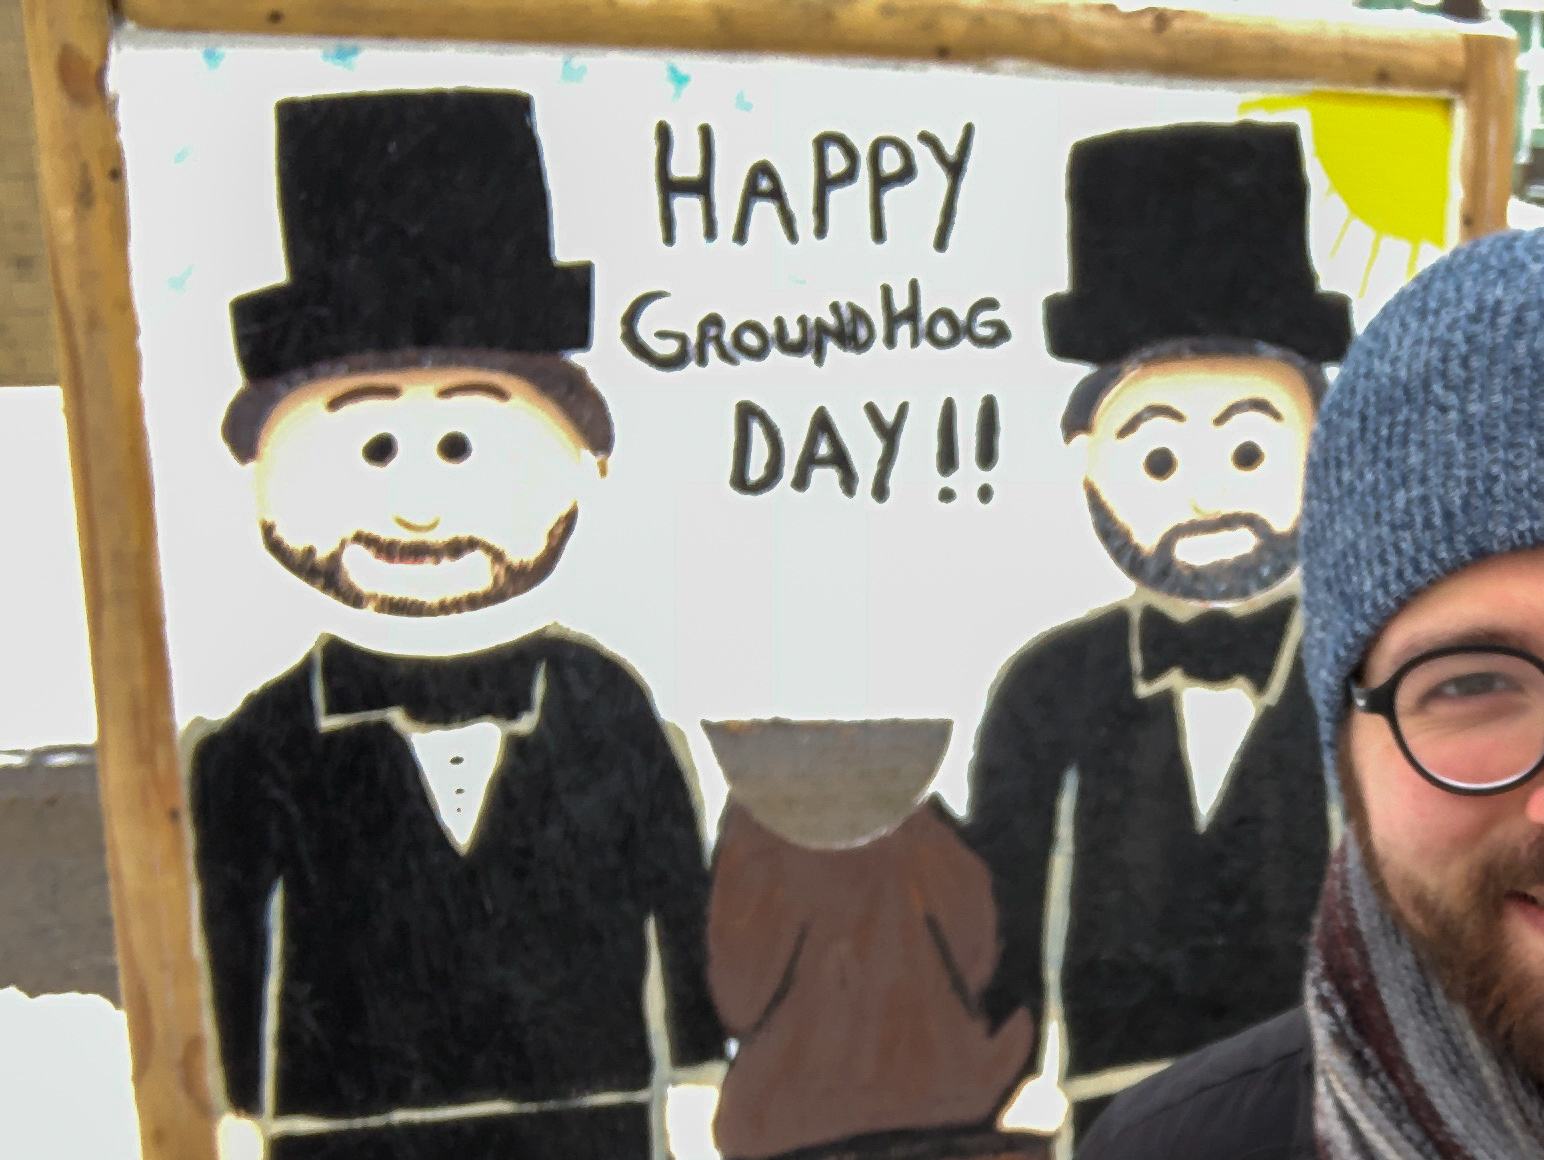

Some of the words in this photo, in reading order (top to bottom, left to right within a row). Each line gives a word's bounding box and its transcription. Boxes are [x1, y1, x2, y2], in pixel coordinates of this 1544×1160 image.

[654, 119, 975, 254] HAPPY
[620, 277, 1012, 372] GROUNDHOG
[729, 393, 1000, 505] DAY!!
